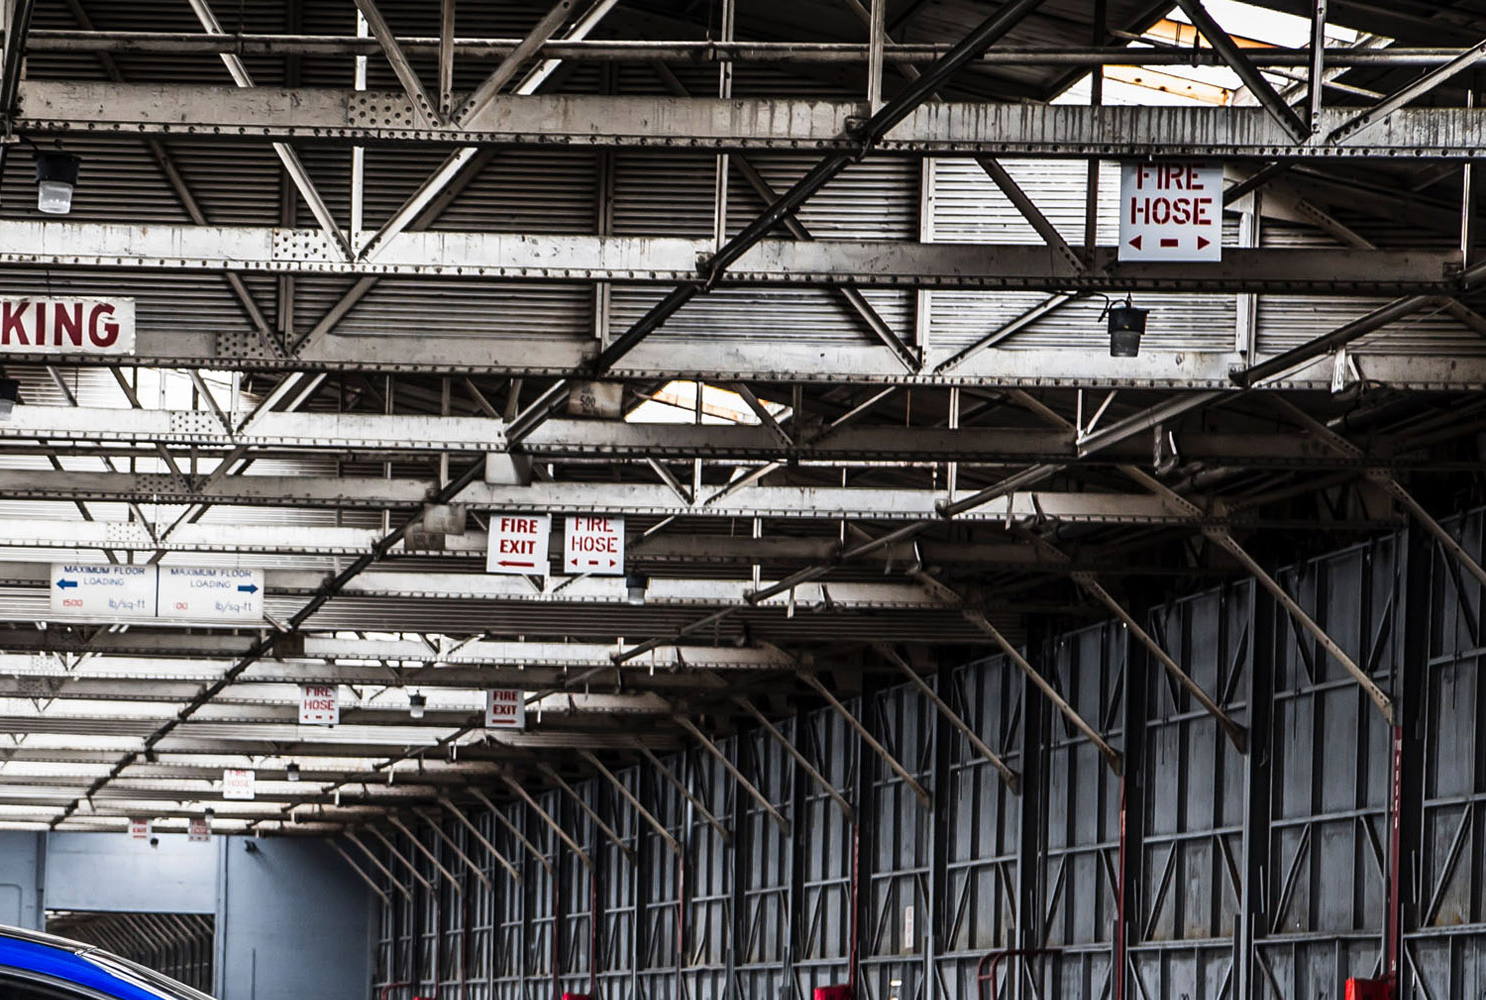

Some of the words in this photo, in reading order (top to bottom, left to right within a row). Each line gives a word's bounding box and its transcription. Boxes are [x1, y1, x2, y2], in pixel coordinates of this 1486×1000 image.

[1136, 162, 1205, 190] FIRE
[1131, 197, 1212, 225] HOSE
[500, 517, 539, 534] FIRE
[575, 516, 614, 532] FIRE
[499, 539, 537, 555] EXIT
[571, 536, 618, 553] HOSE
[64, 565, 110, 575] MAXIMUM
[114, 566, 146, 575] FLOOR
[170, 568, 217, 577] MAXIMUM
[220, 569, 252, 578] FLOOR
[83, 577, 125, 586] LOADING
[190, 580, 232, 589] LOADING
[62, 599, 84, 607] 1500
[305, 685, 332, 697] FIRE
[493, 690, 518, 701] FIRE
[303, 700, 335, 711] HOSE
[492, 704, 518, 716] EXIT
